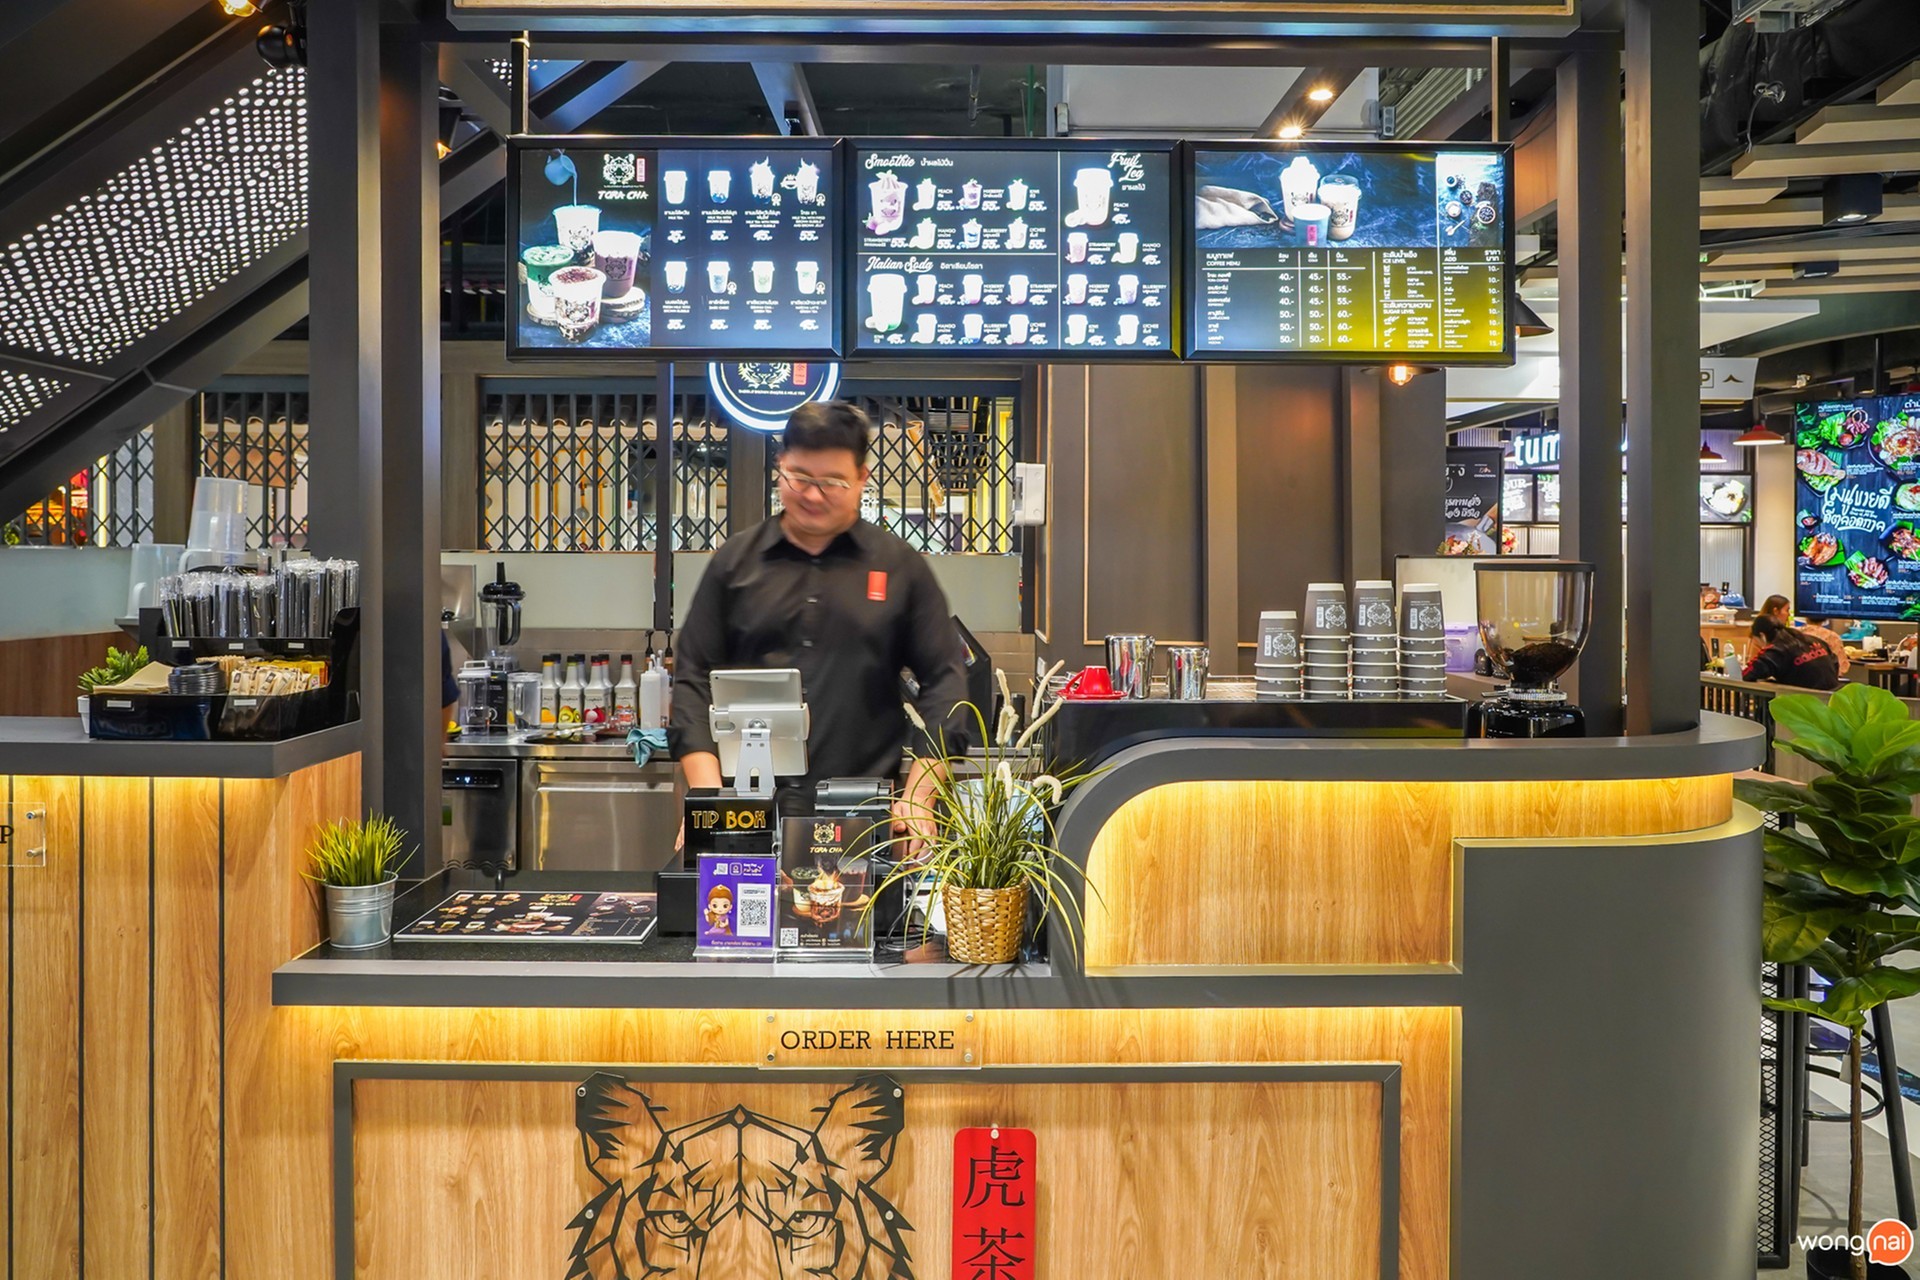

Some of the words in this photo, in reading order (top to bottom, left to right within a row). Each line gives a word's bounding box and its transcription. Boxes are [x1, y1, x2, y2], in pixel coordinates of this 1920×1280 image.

[865, 153, 915, 169] Smoothie
[1107, 152, 1141, 168] Fruit
[1118, 164, 1144, 182] Tea
[598, 190, 625, 200] TORA
[626, 190, 649, 200] CHA
[865, 256, 903, 272] Italian
[904, 256, 934, 273] Soda
[1206, 252, 1234, 260] เมนูกาแฟ
[1794, 648, 1828, 666] adidas
[692, 811, 719, 828] TIP
[726, 811, 766, 829] BOX
[781, 1030, 872, 1050] ORDER
[886, 1030, 954, 1050] HERE
[961, 1146, 1026, 1280] 虎茶
